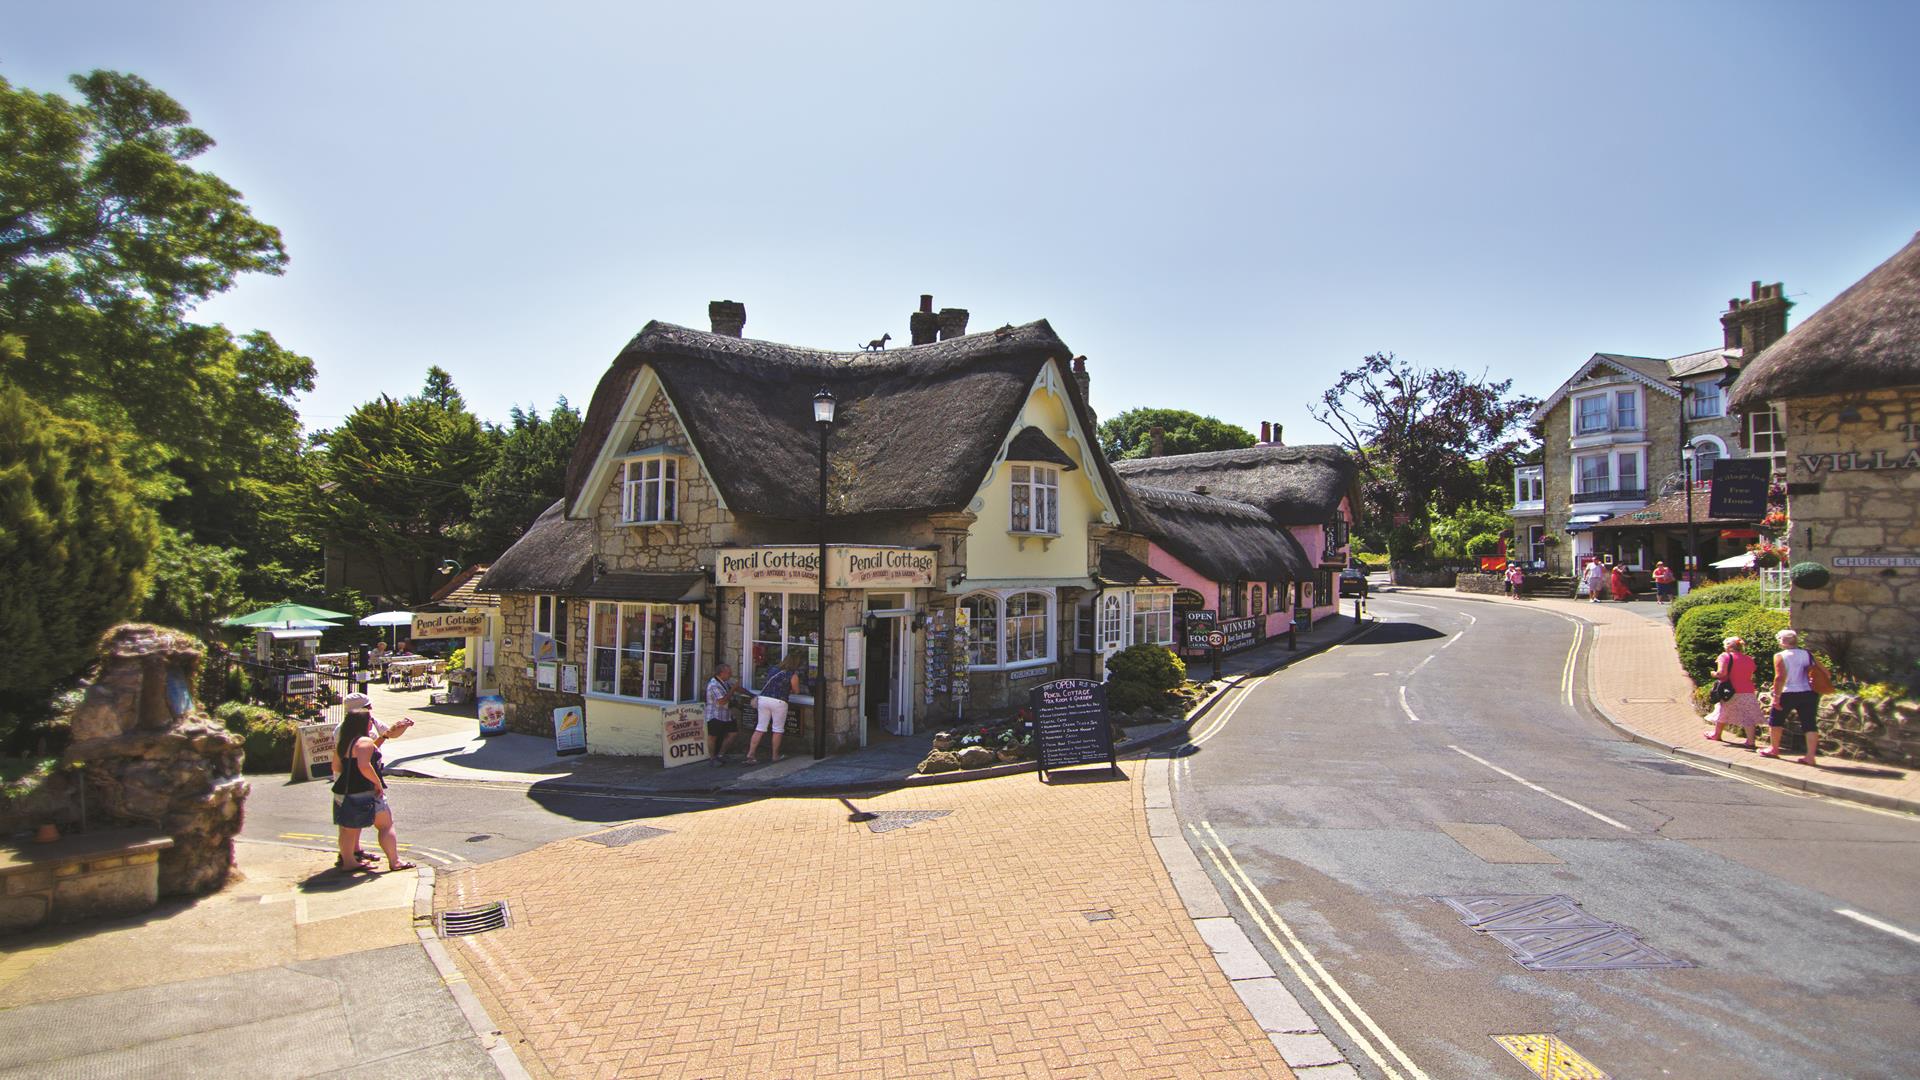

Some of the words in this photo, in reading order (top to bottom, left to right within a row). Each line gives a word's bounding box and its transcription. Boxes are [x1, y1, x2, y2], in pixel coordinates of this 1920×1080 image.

[1723, 497, 1754, 505] House
[723, 551, 758, 573] Pencil
[763, 551, 820, 571] Cottage
[850, 551, 882, 573] Pencil
[887, 550, 932, 572] Cottage
[1836, 558, 1897, 567] CHURCH
[417, 616, 442, 629] Pencil
[446, 615, 482, 625] Cottage
[1222, 619, 1256, 633] WINNERS
[1190, 634, 1208, 642] FOO
[1211, 634, 1220, 642] 20
[1055, 680, 1075, 690] OPEN
[673, 721, 691, 729] SHOP
[671, 730, 701, 741] GARDEN
[670, 742, 704, 758] OPEN
